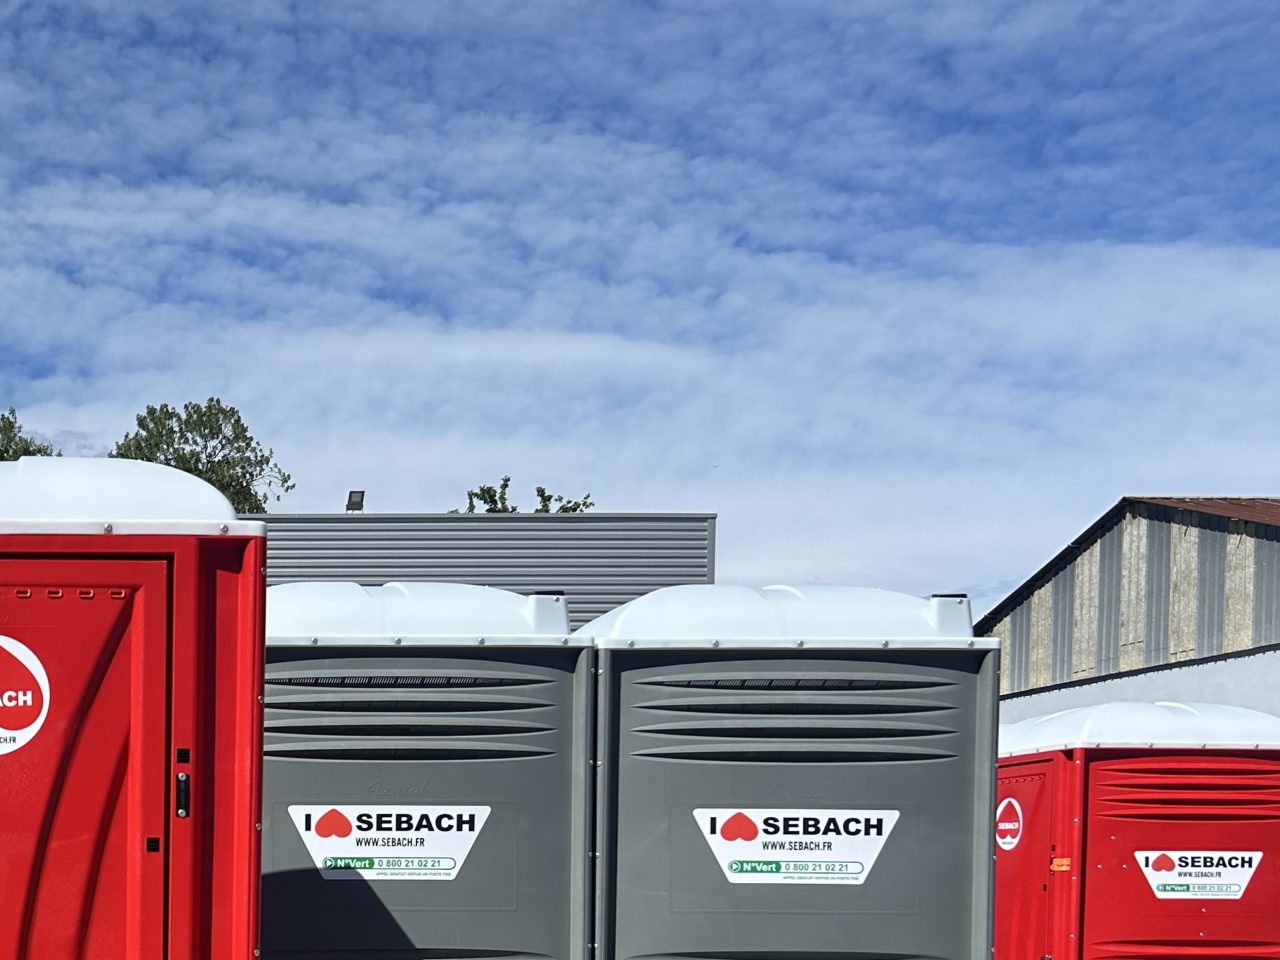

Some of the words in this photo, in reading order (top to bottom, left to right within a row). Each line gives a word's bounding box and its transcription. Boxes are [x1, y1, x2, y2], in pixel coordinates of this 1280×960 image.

[304, 814, 312, 832] I
[356, 813, 476, 832] SEBACH
[710, 817, 717, 834] I
[762, 816, 884, 836] SEBACH
[356, 838, 425, 847] WWW.SEBACH.FR
[762, 841, 832, 851] WWW.SEBACH.FR
[337, 858, 370, 868] N°Vert
[1144, 856, 1150, 868] I
[1178, 856, 1253, 868] SEBACH
[743, 863, 776, 872] N°Vert
[784, 864, 790, 872] 0
[793, 864, 809, 872] 800
[812, 864, 822, 872] 21
[825, 864, 836, 872] 02
[839, 864, 848, 872] 21
